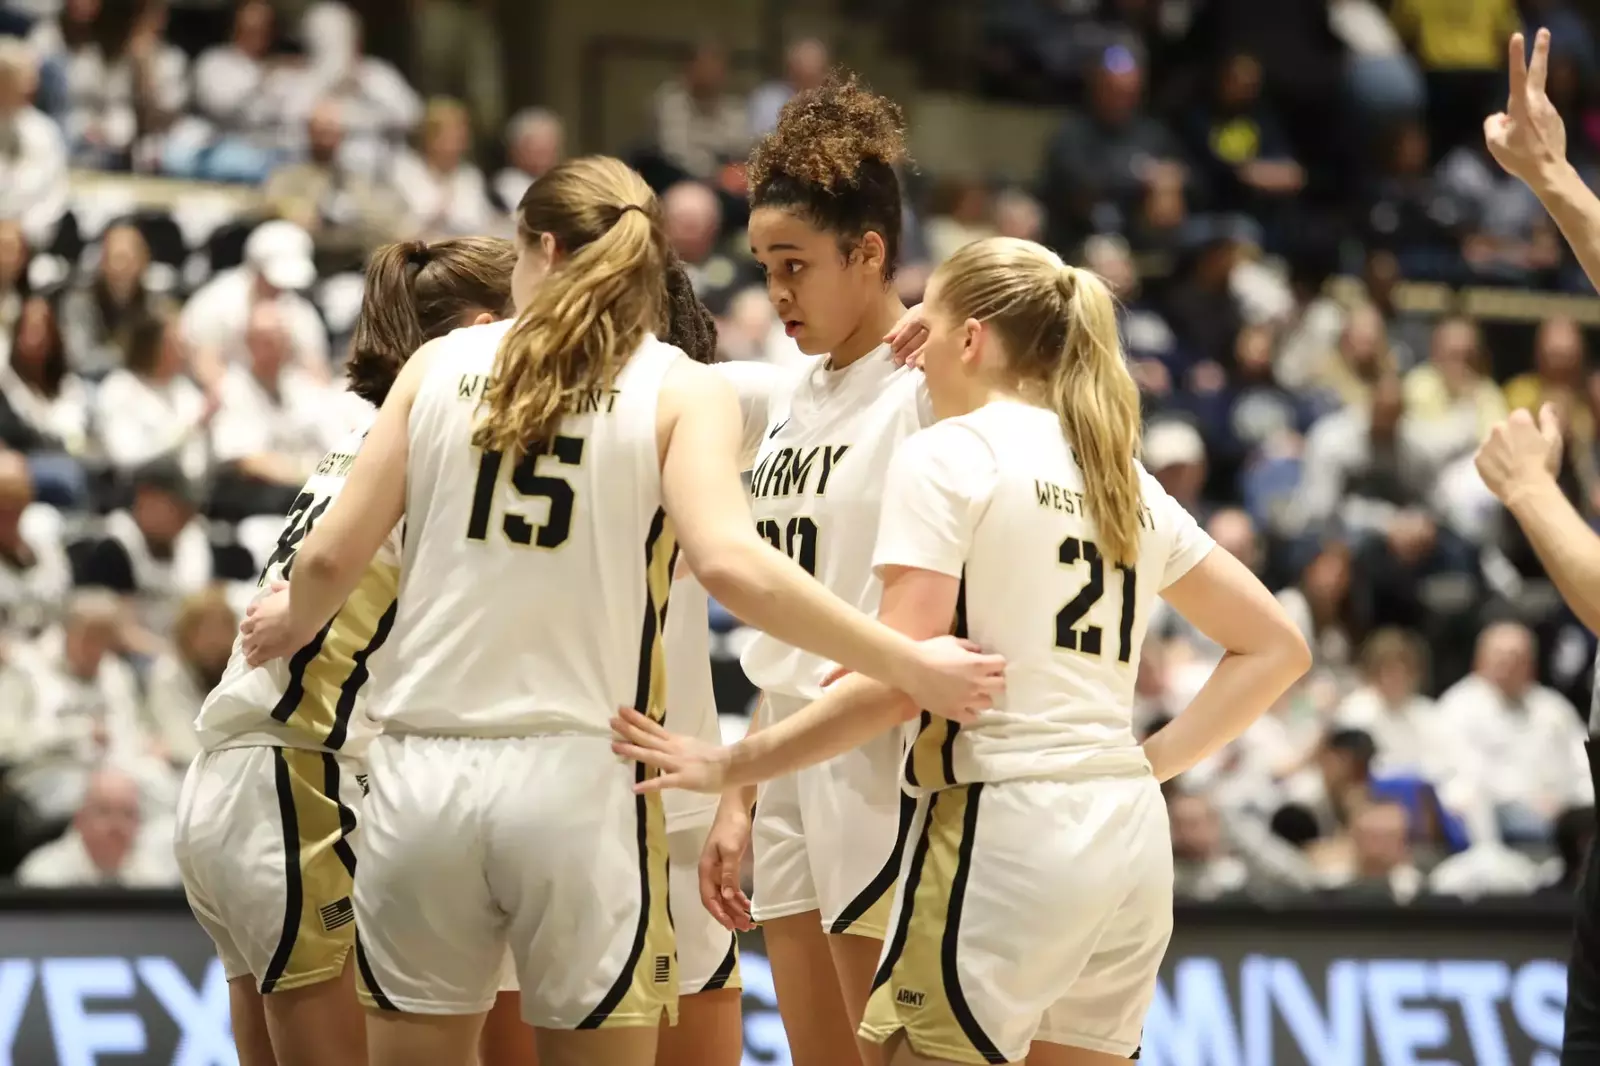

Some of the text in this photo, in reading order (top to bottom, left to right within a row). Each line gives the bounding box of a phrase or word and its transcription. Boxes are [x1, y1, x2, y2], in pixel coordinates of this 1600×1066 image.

[467, 434, 584, 549] 15
[751, 444, 850, 499] ARMY
[1034, 478, 1085, 518] WEST
[1055, 535, 1137, 664] 21
[896, 987, 926, 1007] ARMY
